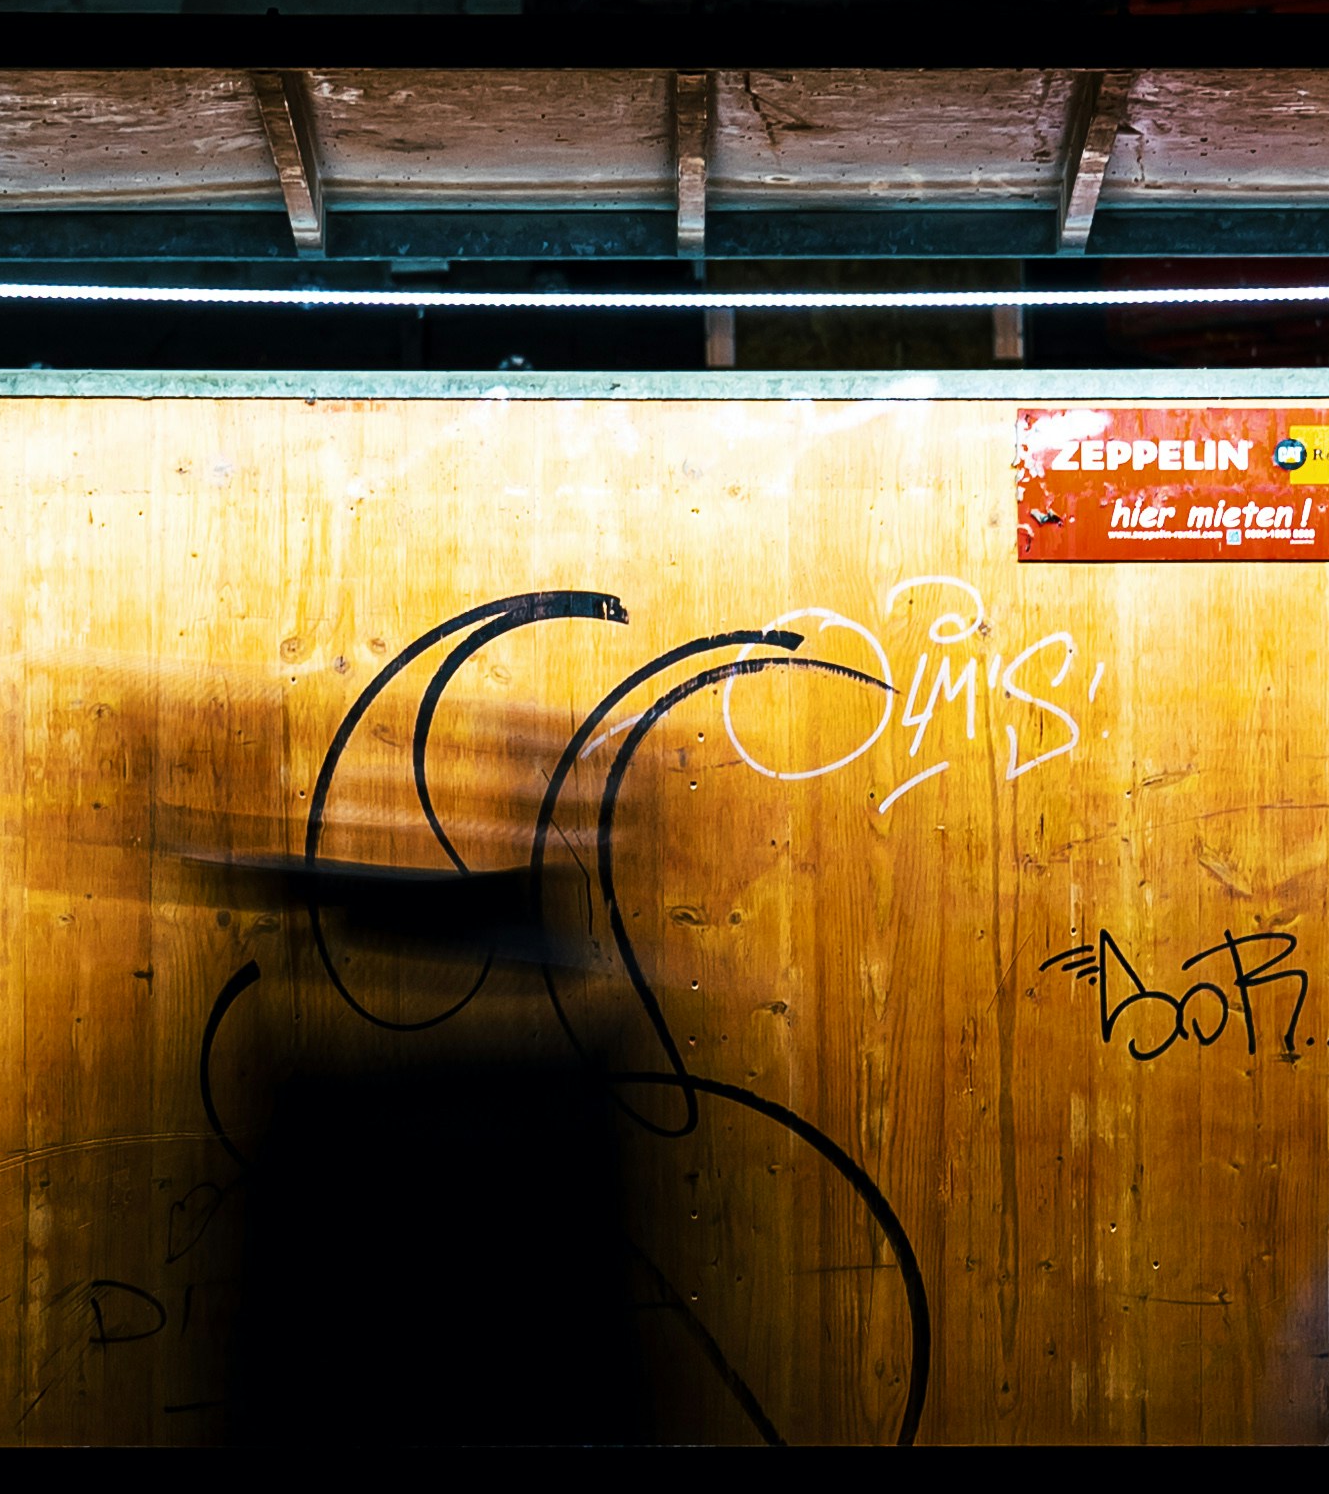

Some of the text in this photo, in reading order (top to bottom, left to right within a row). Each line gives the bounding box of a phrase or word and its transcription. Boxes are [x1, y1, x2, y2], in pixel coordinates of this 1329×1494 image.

[1051, 439, 1249, 471] ZEPPELIN
[1110, 497, 1313, 528] hier mieten!
